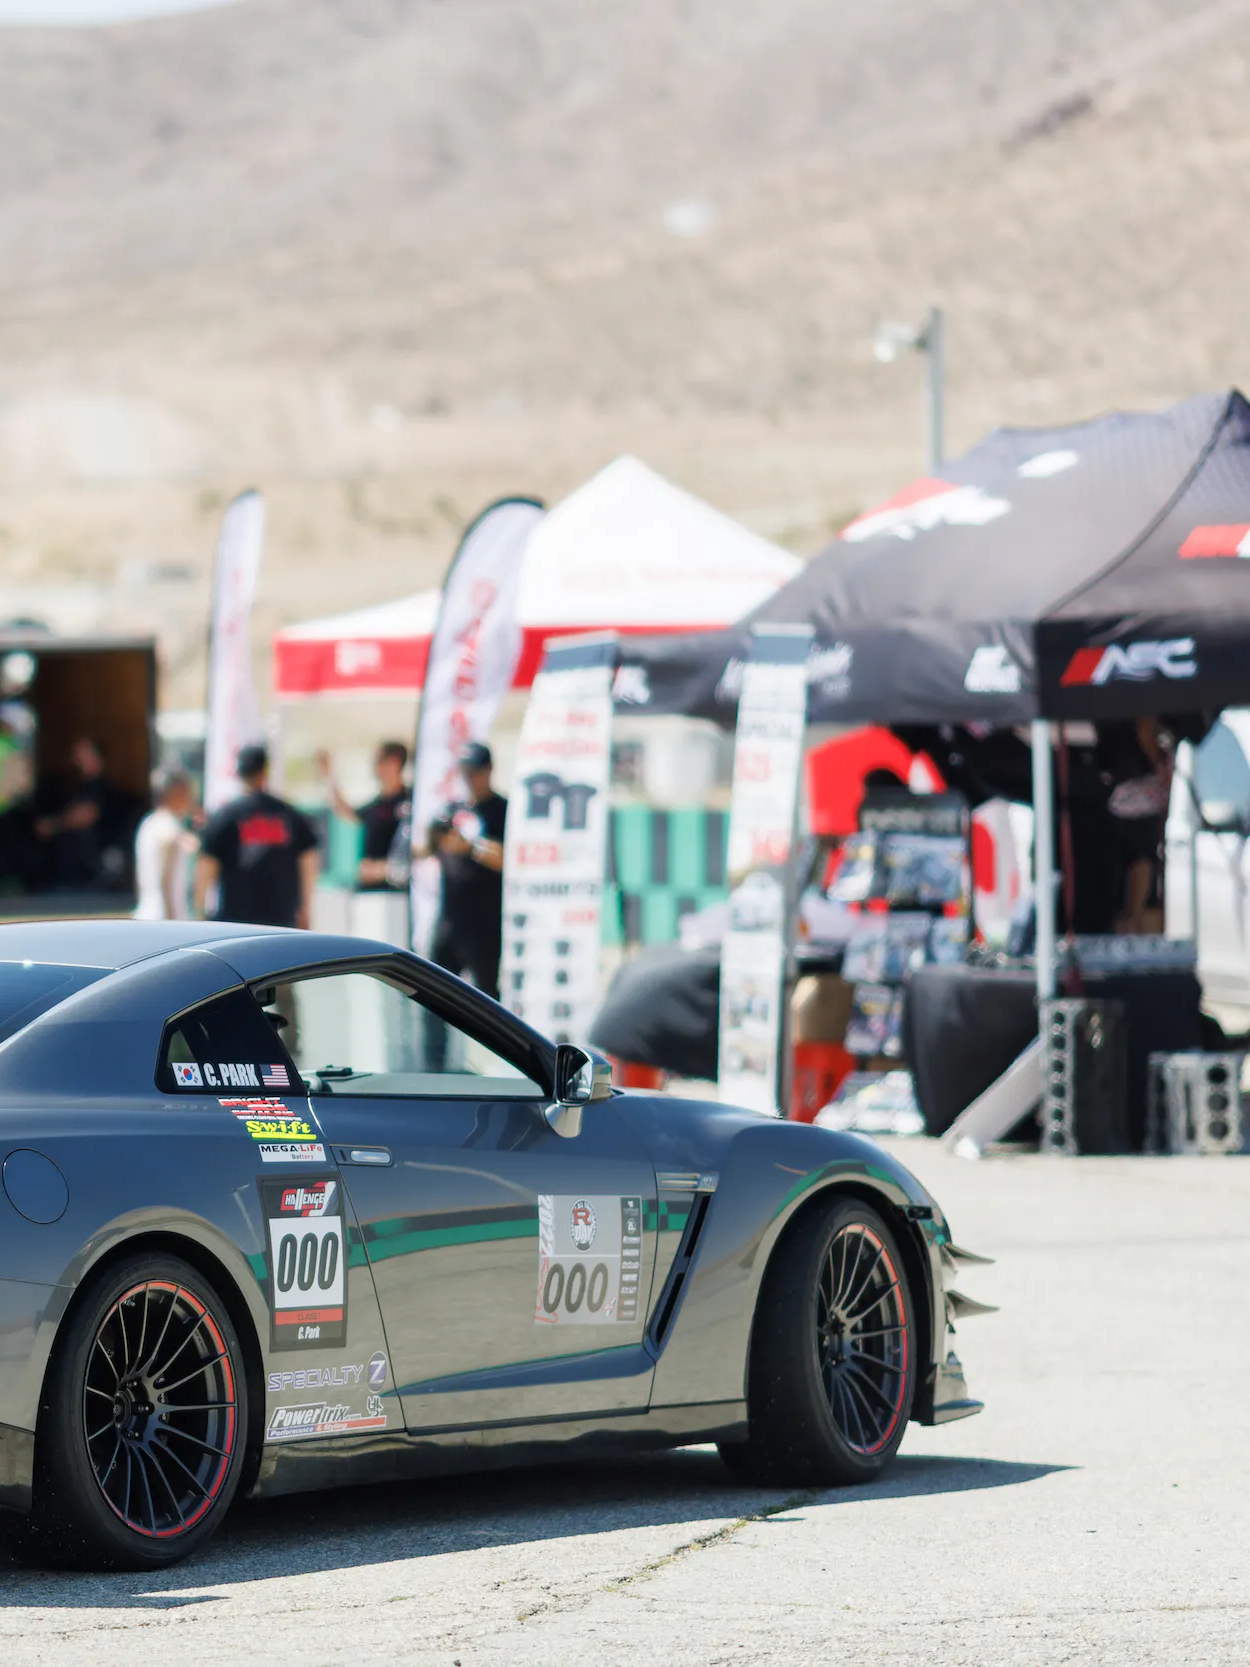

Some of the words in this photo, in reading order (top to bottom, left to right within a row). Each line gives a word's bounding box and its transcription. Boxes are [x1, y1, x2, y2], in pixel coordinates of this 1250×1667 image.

[203, 1063, 221, 1086] C.
[218, 1063, 260, 1086] PARK
[277, 1231, 339, 1293] 000
[543, 1262, 608, 1314] 000
[305, 1325, 320, 1339] Park
[268, 1365, 364, 1391] SPECIALTY
[369, 1360, 386, 1384] Z
[270, 1426, 313, 1437] Performance
[324, 1421, 348, 1431] Styling
